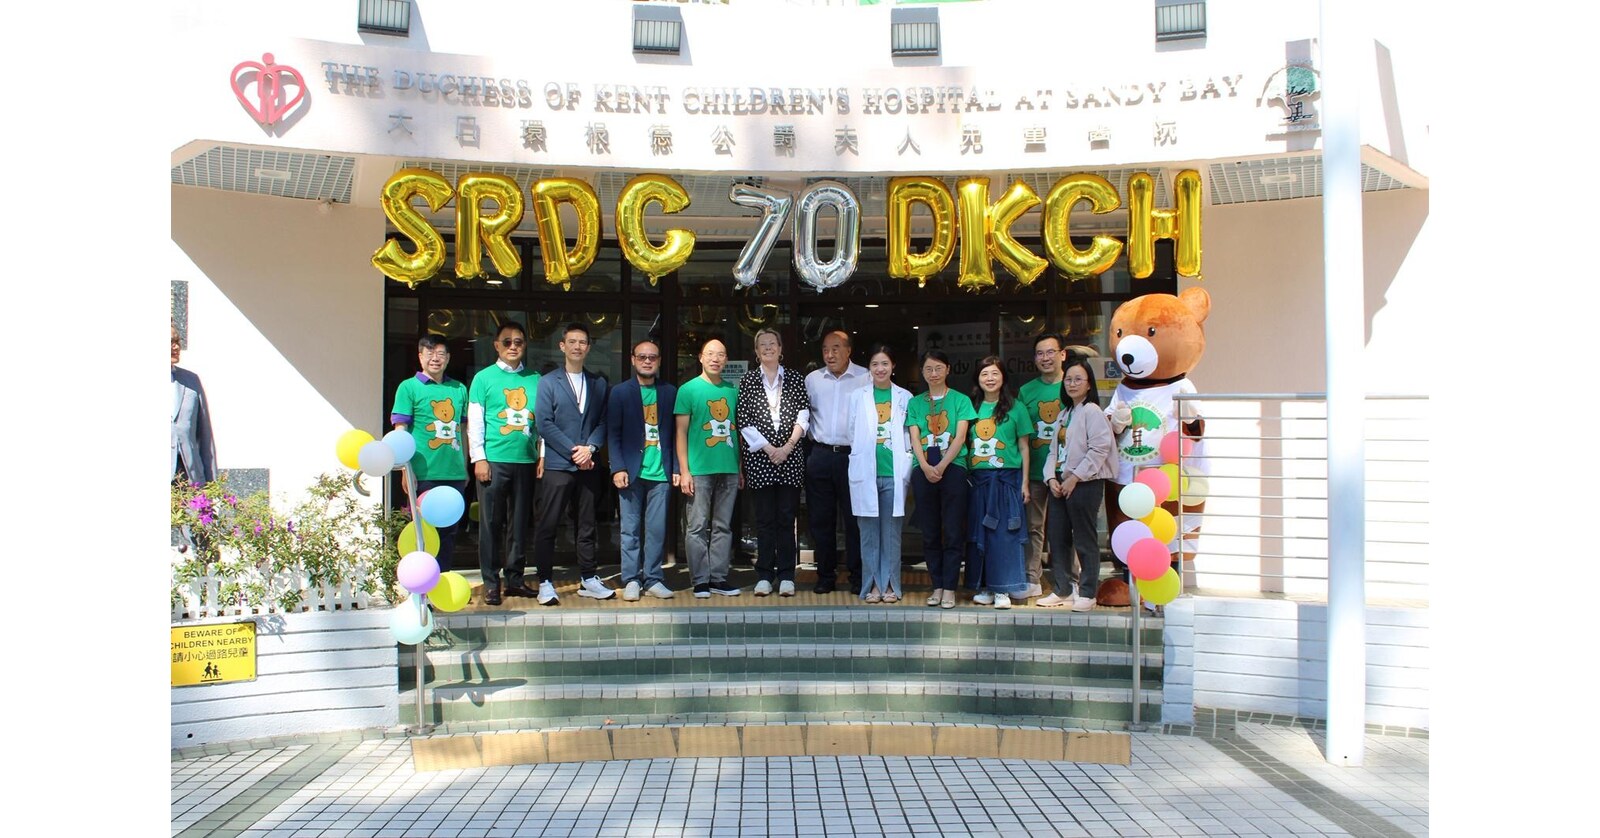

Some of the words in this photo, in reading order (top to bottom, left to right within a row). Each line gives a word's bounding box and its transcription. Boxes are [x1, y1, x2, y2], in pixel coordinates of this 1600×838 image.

[321, 61, 383, 94] THE
[393, 69, 532, 105] DUCHESS
[543, 81, 582, 109] OF
[593, 82, 670, 112] KENT
[682, 86, 851, 115] CHILDREN'S
[862, 86, 1002, 114] HOSPITAL
[1014, 86, 1053, 111] AT
[1066, 81, 1168, 110] SANDY
[1179, 73, 1244, 102] BAY
[371, 167, 696, 287] SRDC
[728, 178, 863, 290] 70
[886, 168, 1203, 288] DKCH
[184, 629, 223, 638] BEWARE
[217, 637, 253, 645] NEARBY
[172, 647, 248, 662] 請小心過路兒童
